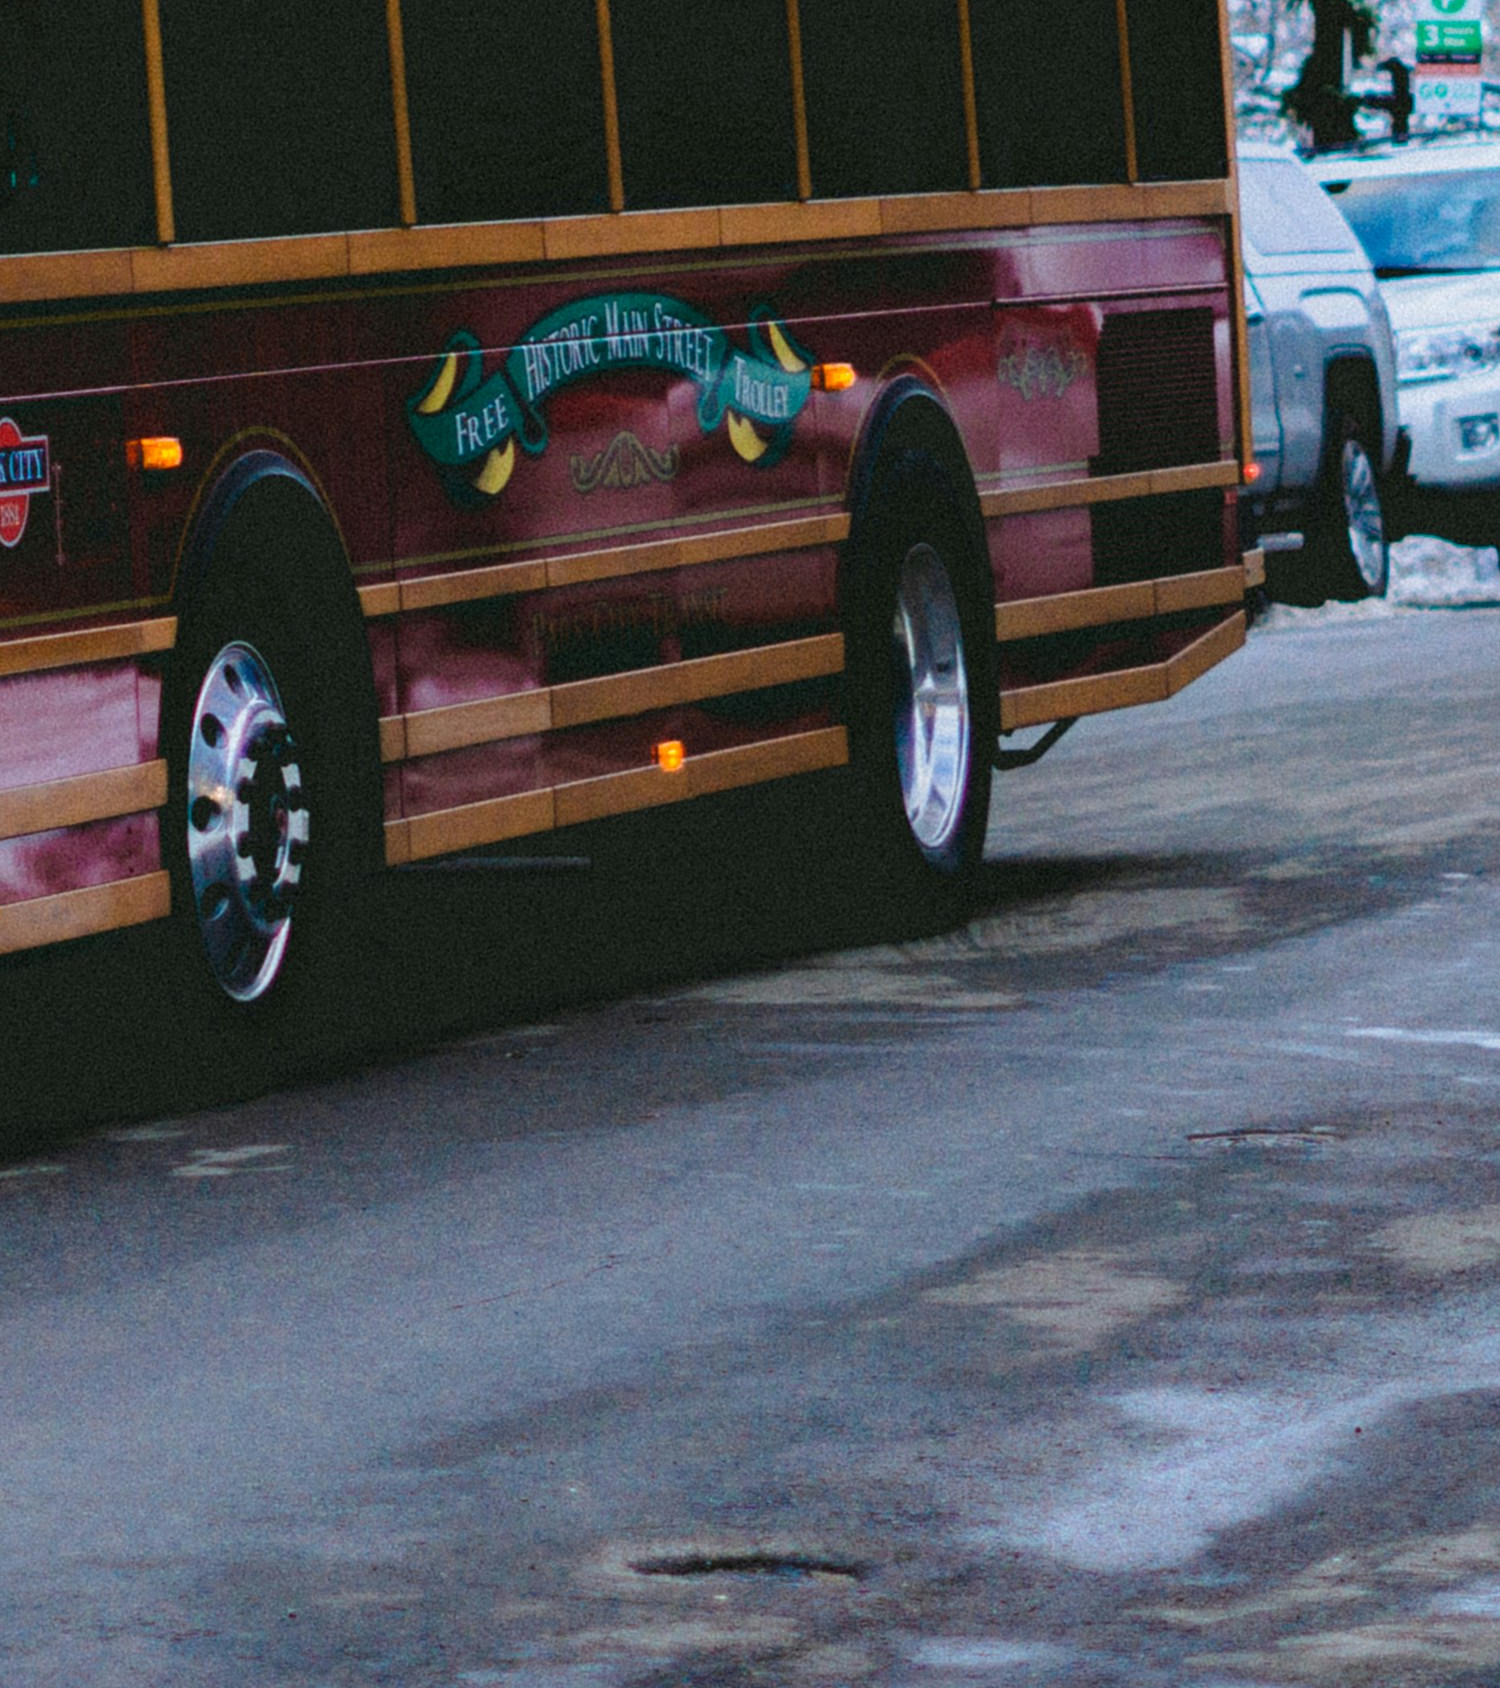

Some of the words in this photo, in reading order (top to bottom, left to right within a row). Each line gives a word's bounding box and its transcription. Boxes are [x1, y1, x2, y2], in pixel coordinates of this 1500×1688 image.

[1424, 25, 1439, 47] 3
[454, 392, 509, 456] FREE
[521, 315, 600, 402] HISTORIC
[605, 301, 649, 361] MAIN
[653, 302, 714, 382] STREET
[733, 354, 789, 418] TROLLEY
[9, 448, 44, 481] CITY
